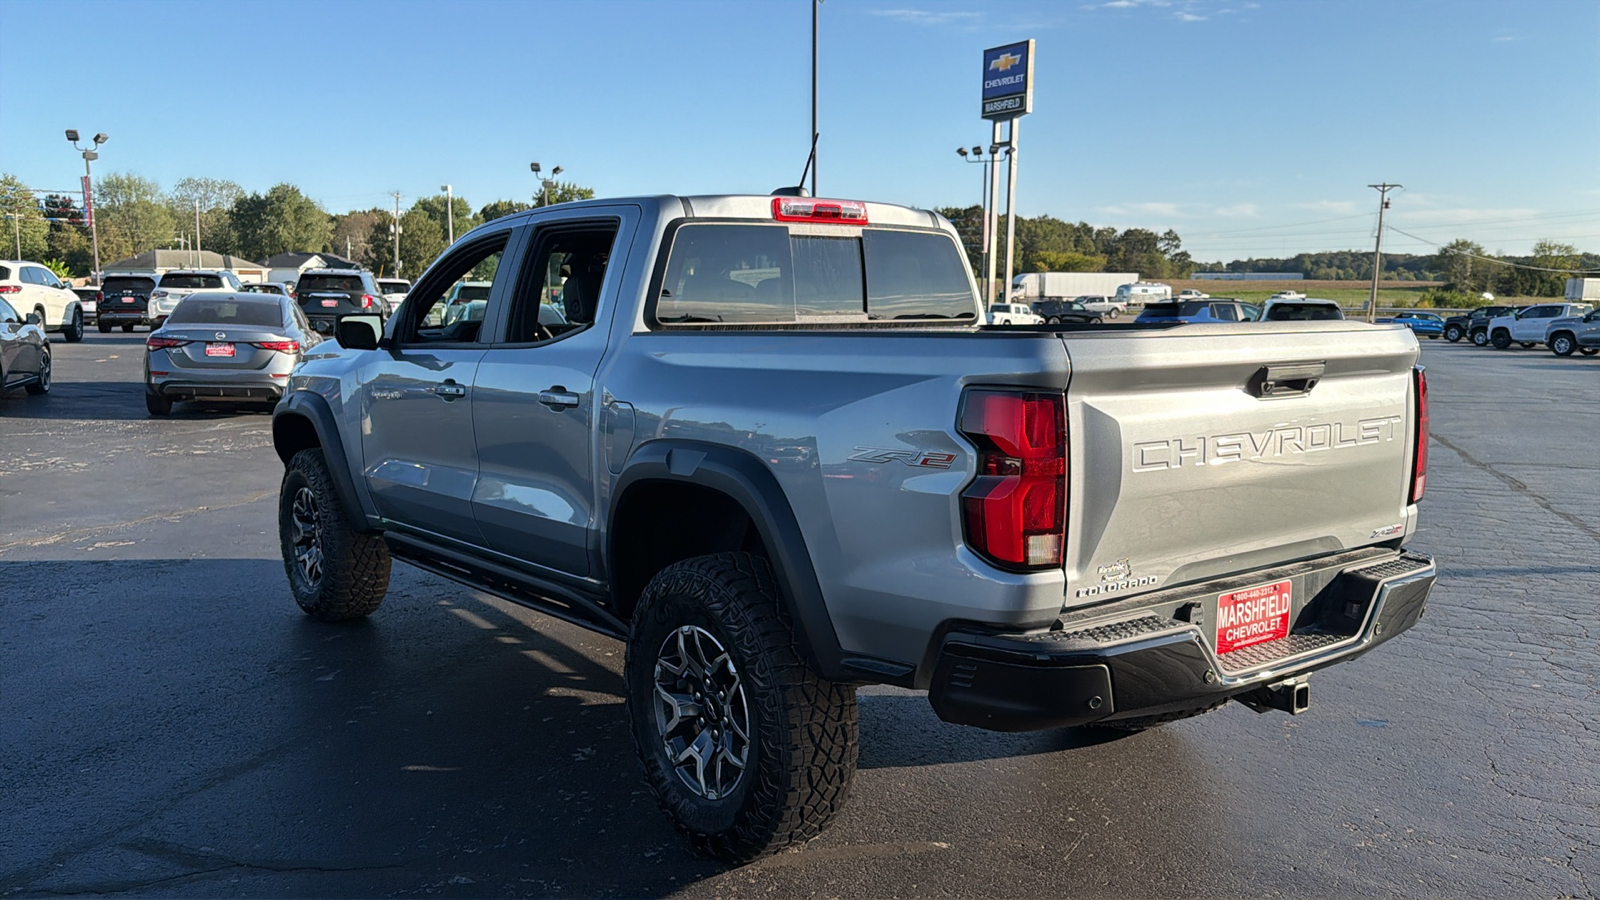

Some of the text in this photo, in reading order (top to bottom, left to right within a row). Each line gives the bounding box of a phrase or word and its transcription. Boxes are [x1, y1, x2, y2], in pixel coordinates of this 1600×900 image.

[984, 74, 1024, 88] CHEVROLET
[985, 98, 1020, 112] MARSHFIELD
[1132, 415, 1401, 472] CHEVROLET
[847, 446, 957, 469] ZR2
[1076, 576, 1158, 598] COLORADO
[1218, 592, 1289, 629] MARSHFIELD
[1226, 616, 1282, 642] CHEVROLET
